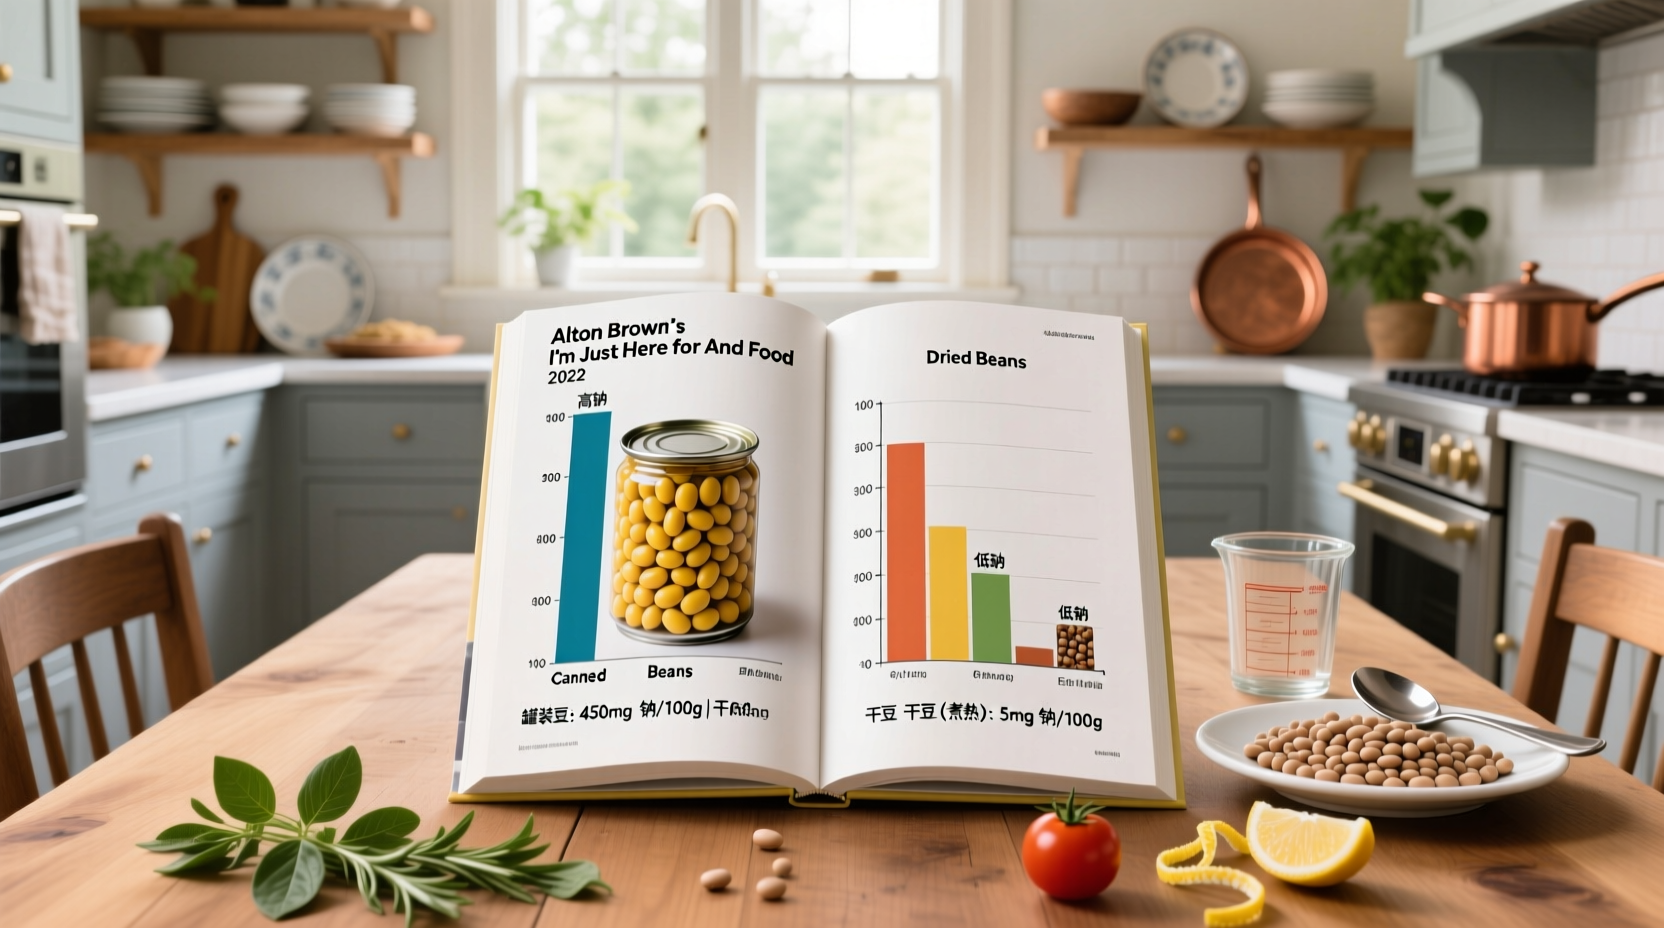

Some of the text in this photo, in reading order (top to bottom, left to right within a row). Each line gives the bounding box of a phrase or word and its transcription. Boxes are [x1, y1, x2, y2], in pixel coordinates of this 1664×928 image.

[550, 318, 685, 345] Alton Brown's
[549, 338, 795, 366] I'm Just Here for And Food
[926, 349, 1027, 369] Dried Beans
[548, 368, 586, 385] 2022
[855, 400, 874, 411] 100
[551, 665, 693, 685] Canned Beans
[579, 704, 632, 722] 450mg
[865, 705, 898, 723] 干豆
[1000, 706, 1034, 727] 5mg
